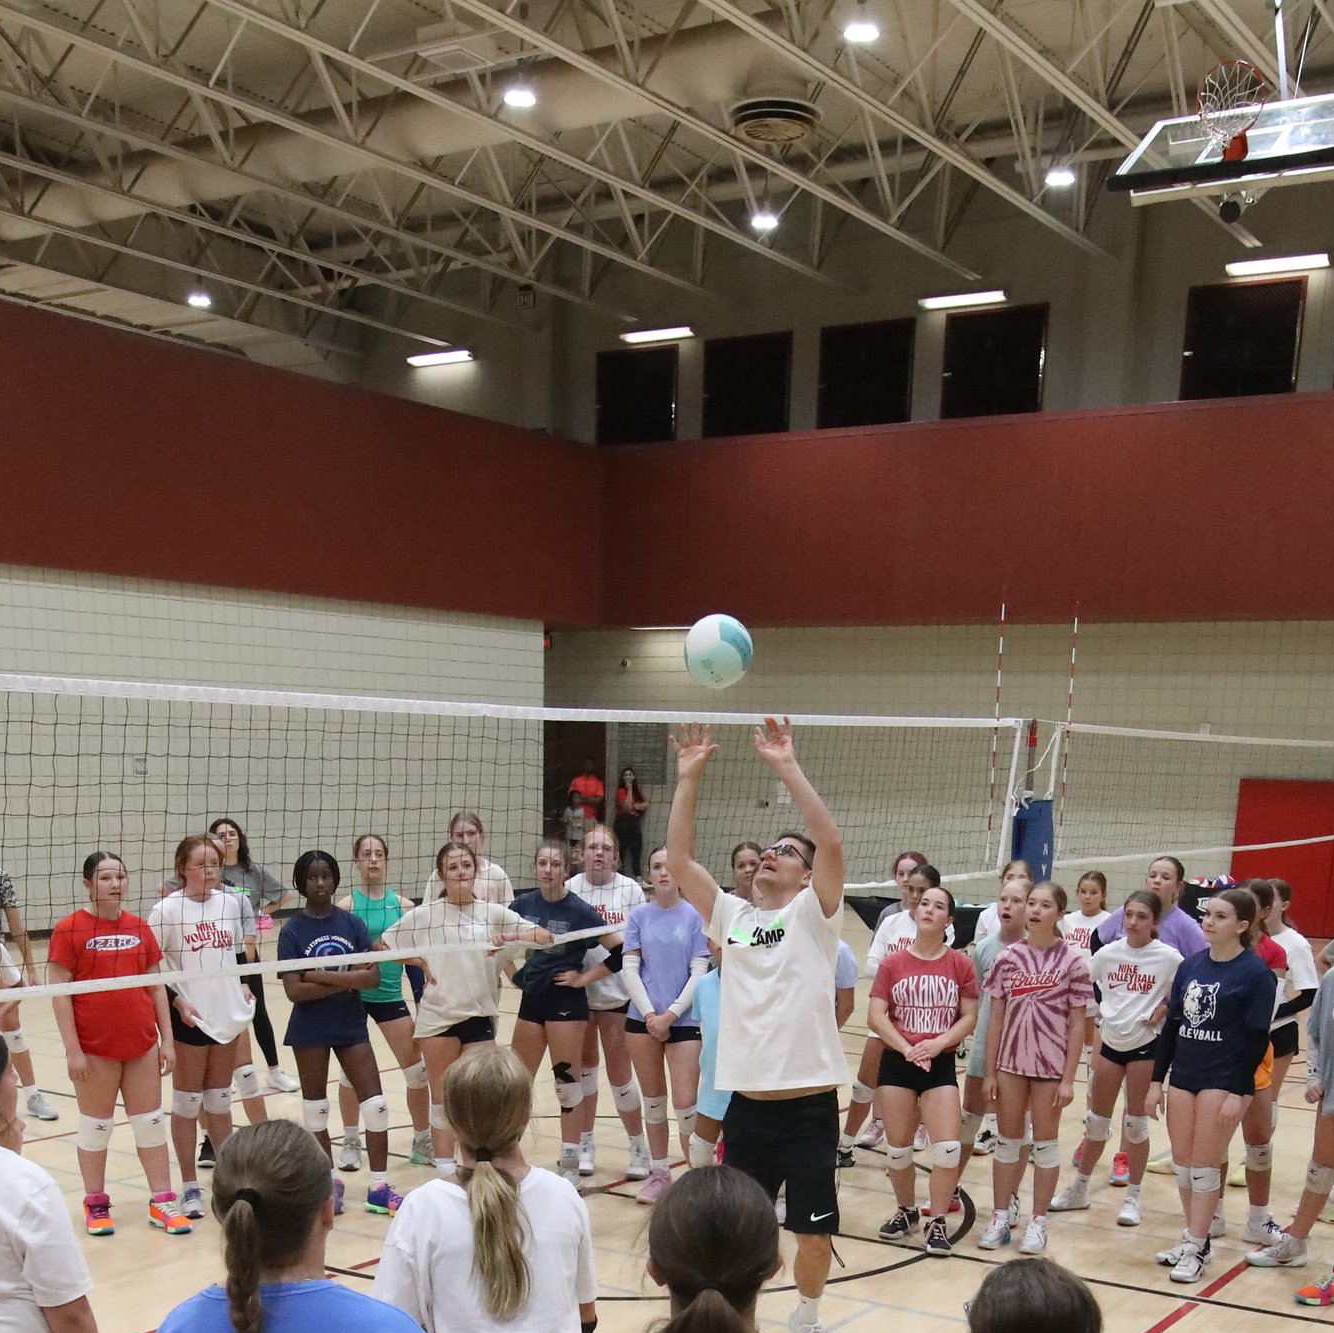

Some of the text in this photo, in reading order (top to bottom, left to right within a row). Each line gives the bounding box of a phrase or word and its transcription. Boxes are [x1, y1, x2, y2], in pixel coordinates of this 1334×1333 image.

[196, 922, 217, 932] NIKE
[85, 937, 141, 949] OZARK
[1118, 963, 1138, 974] NIKE
[1010, 969, 1060, 988] Bristol
[1108, 972, 1156, 984] VOLLEYBALL
[1127, 982, 1152, 992] CAMP
